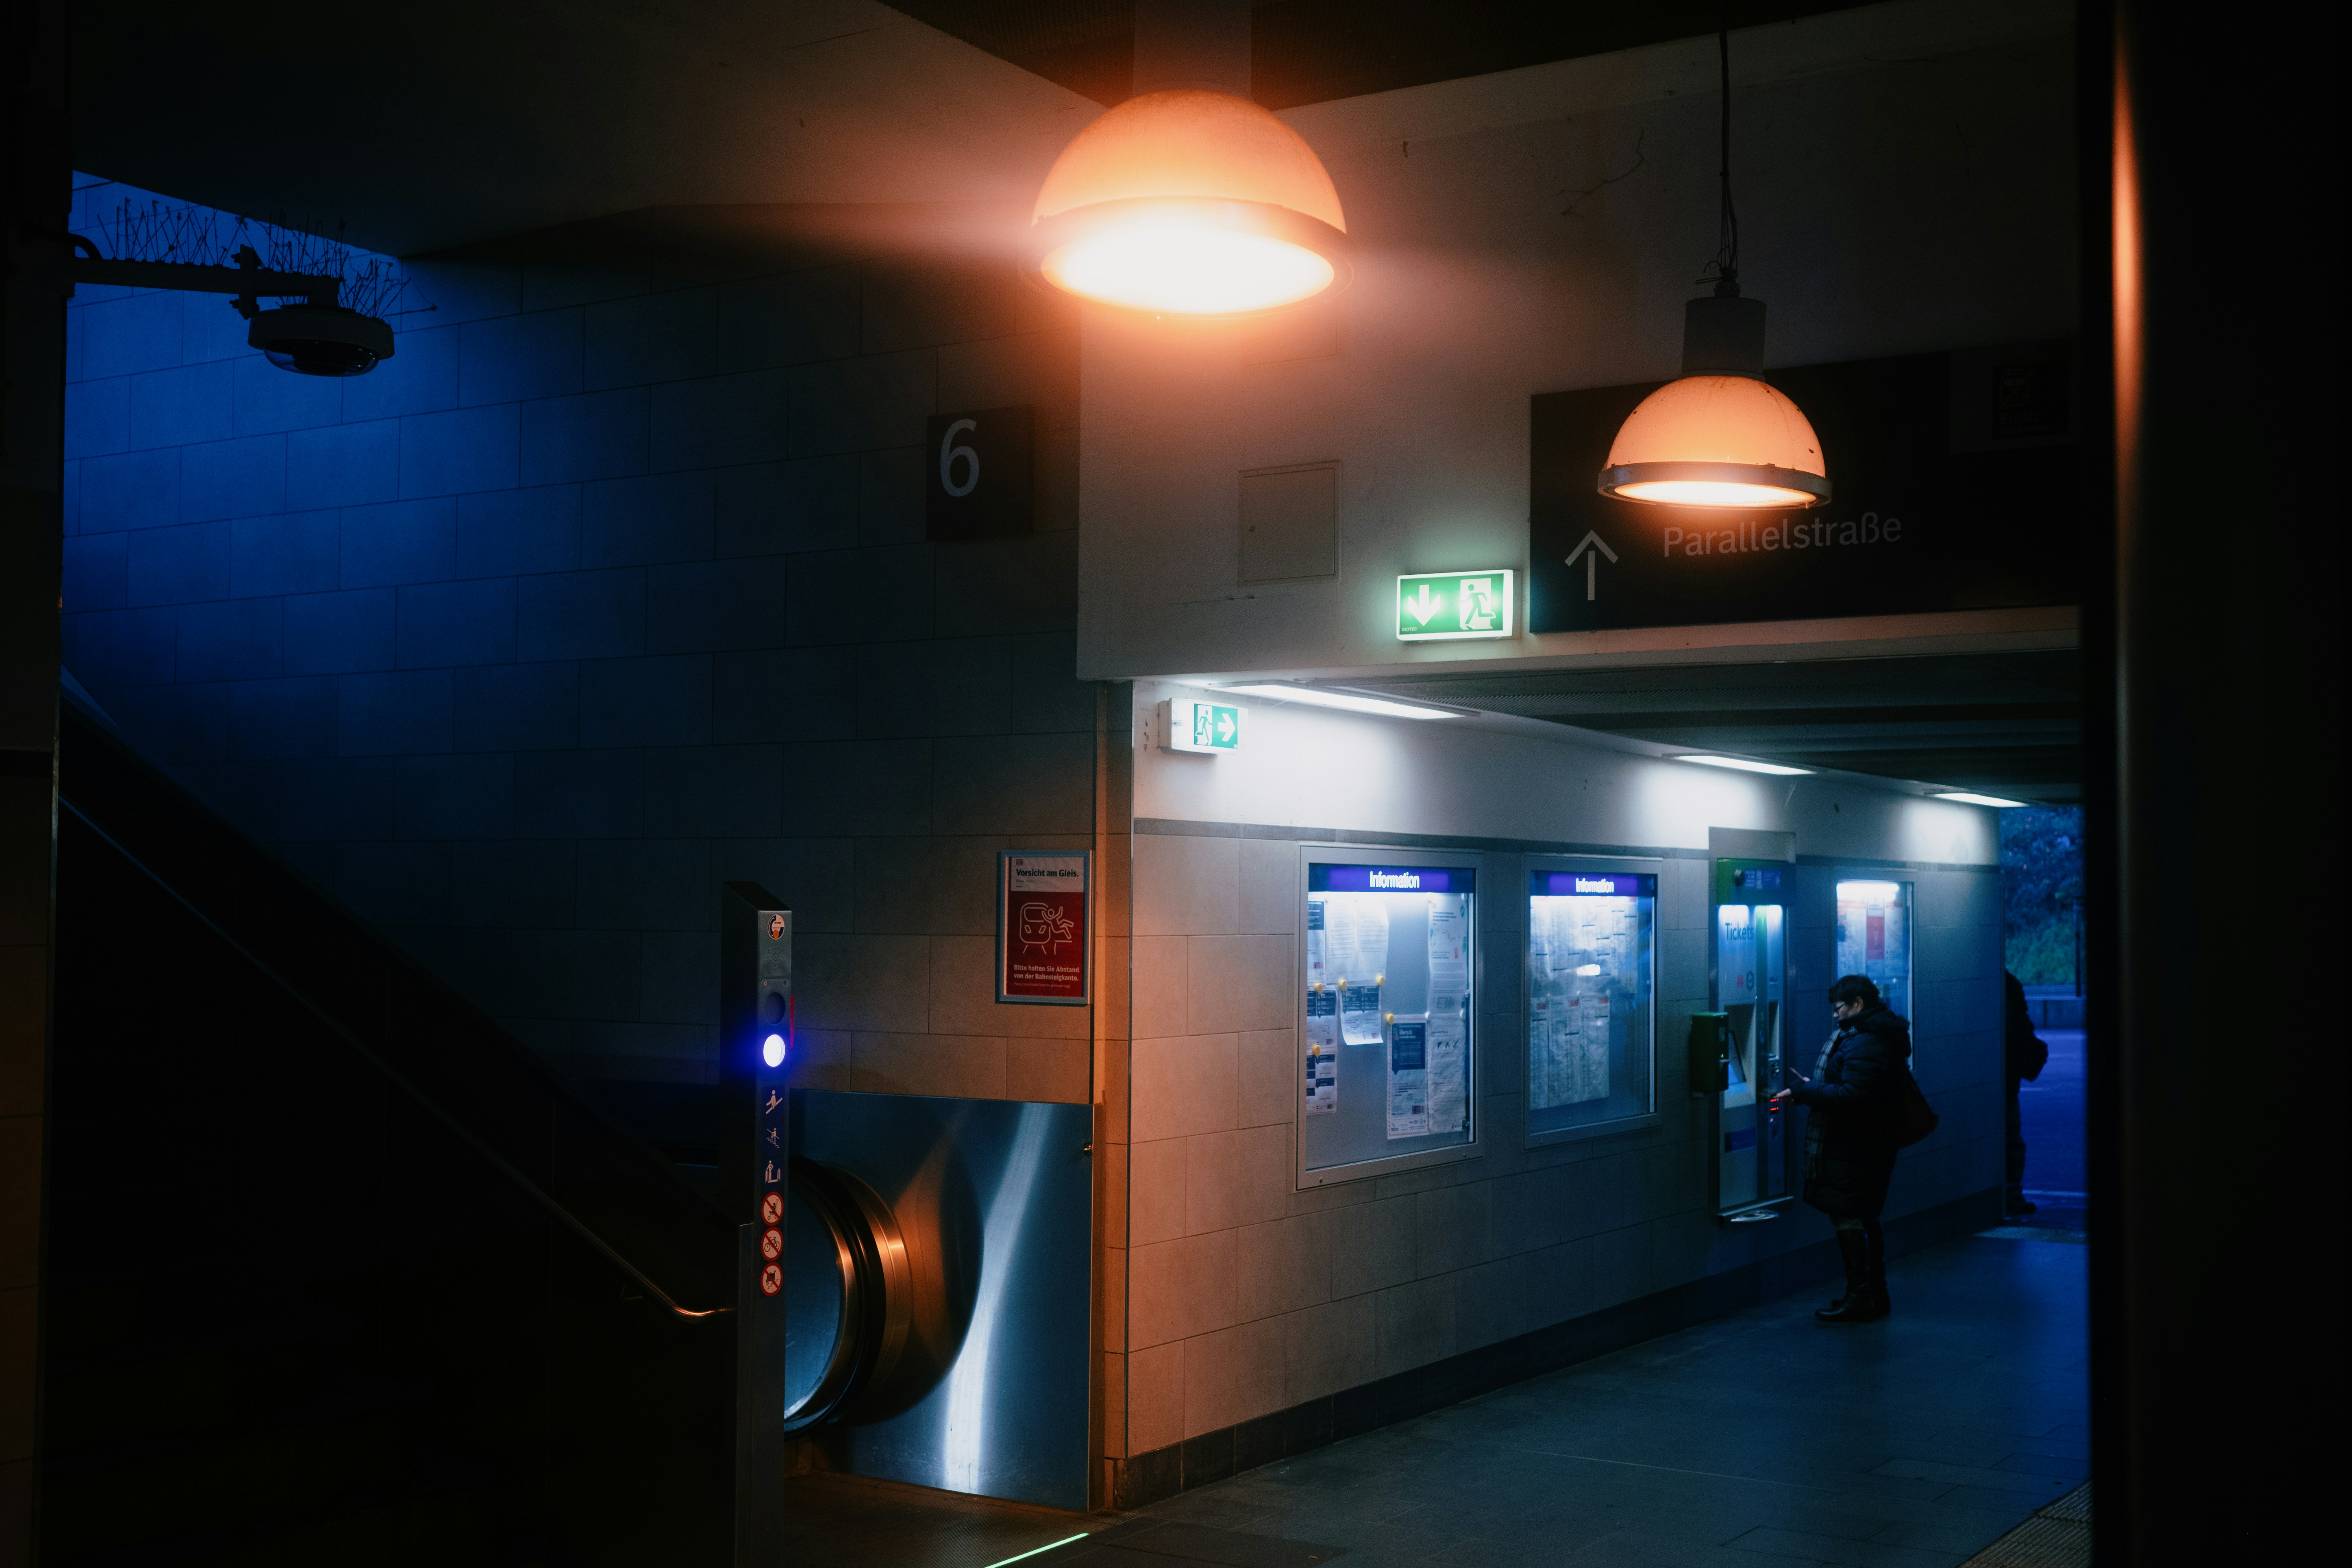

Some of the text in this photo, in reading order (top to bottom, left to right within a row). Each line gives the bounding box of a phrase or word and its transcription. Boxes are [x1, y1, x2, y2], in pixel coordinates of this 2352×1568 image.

[2000, 411, 2040, 425] Ersatz
[940, 418, 979, 497] 6
[1664, 511, 1902, 558] Parallelstraße
[1369, 871, 1420, 889] Information
[1576, 877, 1614, 893] Information
[1725, 923, 1754, 940] Tickets
